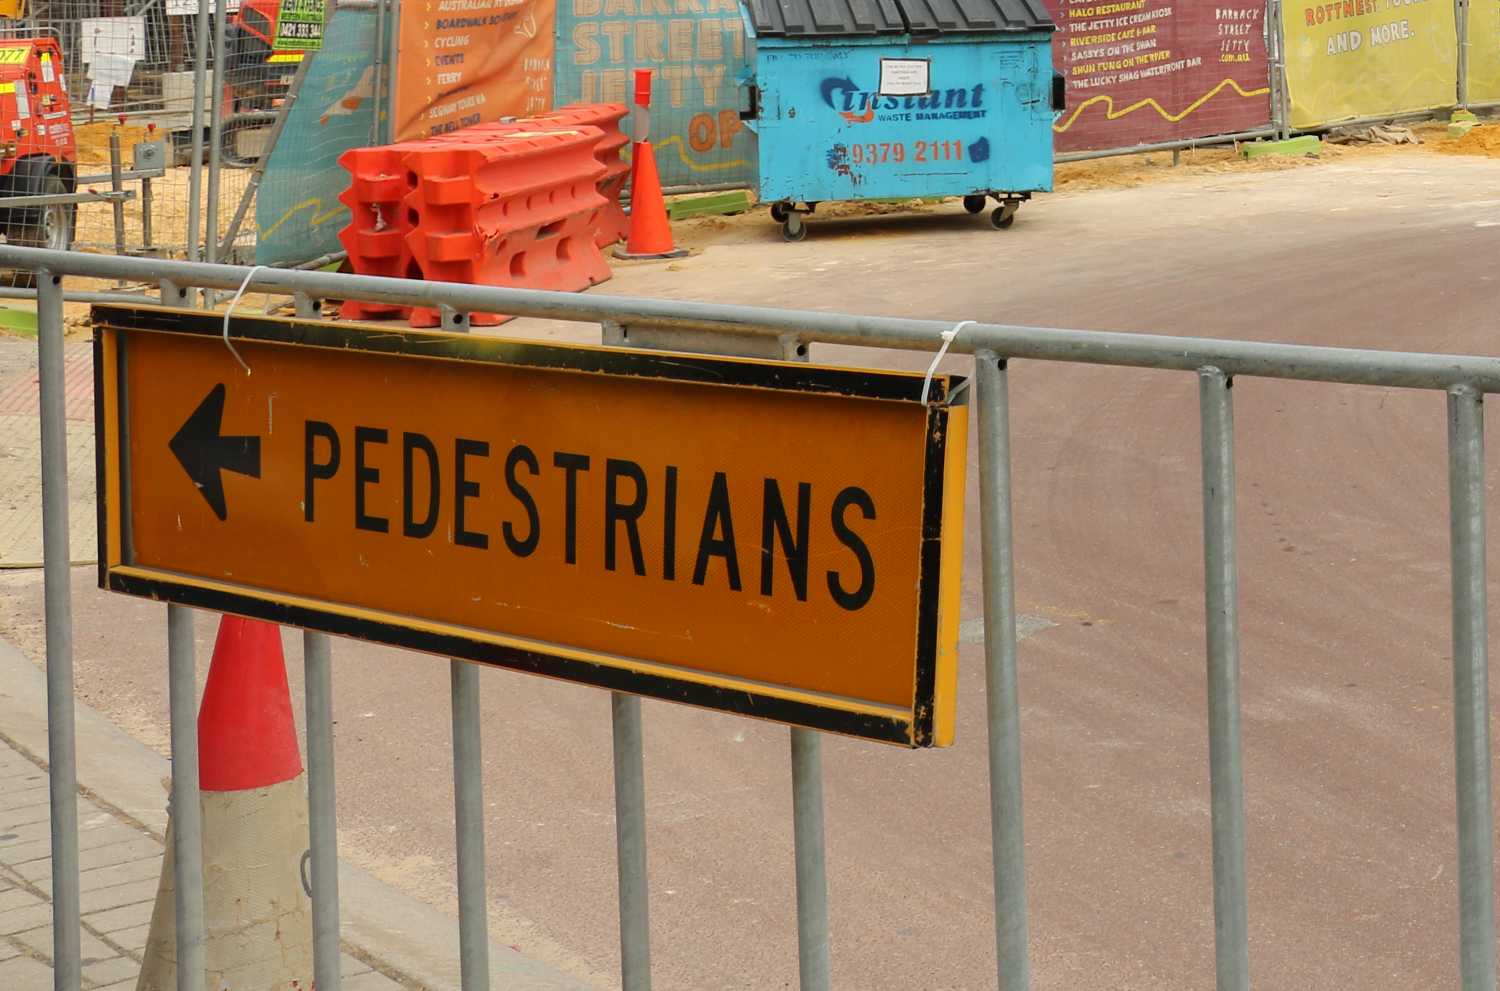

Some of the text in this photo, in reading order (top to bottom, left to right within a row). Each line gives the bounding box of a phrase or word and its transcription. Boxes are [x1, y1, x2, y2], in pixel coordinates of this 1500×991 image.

[438, 0, 492, 12] AUSTRALIAN
[1069, 0, 1146, 18] HALO RESTAURANT
[1215, 8, 1260, 20] BARRACK
[436, 16, 487, 30] BOARDWALK
[1069, 22, 1087, 32] THE
[1088, 18, 1116, 30] JETTY
[1116, 16, 1129, 26] ICE
[1218, 23, 1252, 36] STREET
[434, 34, 470, 48] CYCLING
[1070, 33, 1116, 47] RIVERSIDE
[1220, 39, 1250, 52] JETTY
[1327, 20, 1415, 56] AND MORE.
[1107, 46, 1120, 56] ON
[1121, 42, 1135, 54] THE
[1136, 38, 1157, 51] SWAN
[1122, 57, 1135, 67] ON
[1136, 54, 1150, 65] THE
[1150, 50, 1171, 62] RIVER
[1072, 56, 1202, 89] THE LUCKY SHAG WATERFRONT BAR
[578, 63, 727, 108] JETY
[878, 110, 987, 122] WASTE MANAGEMENT
[688, 109, 744, 154] OP
[852, 139, 963, 164] 9379 2111
[303, 420, 877, 612] PEDESTRIANS
